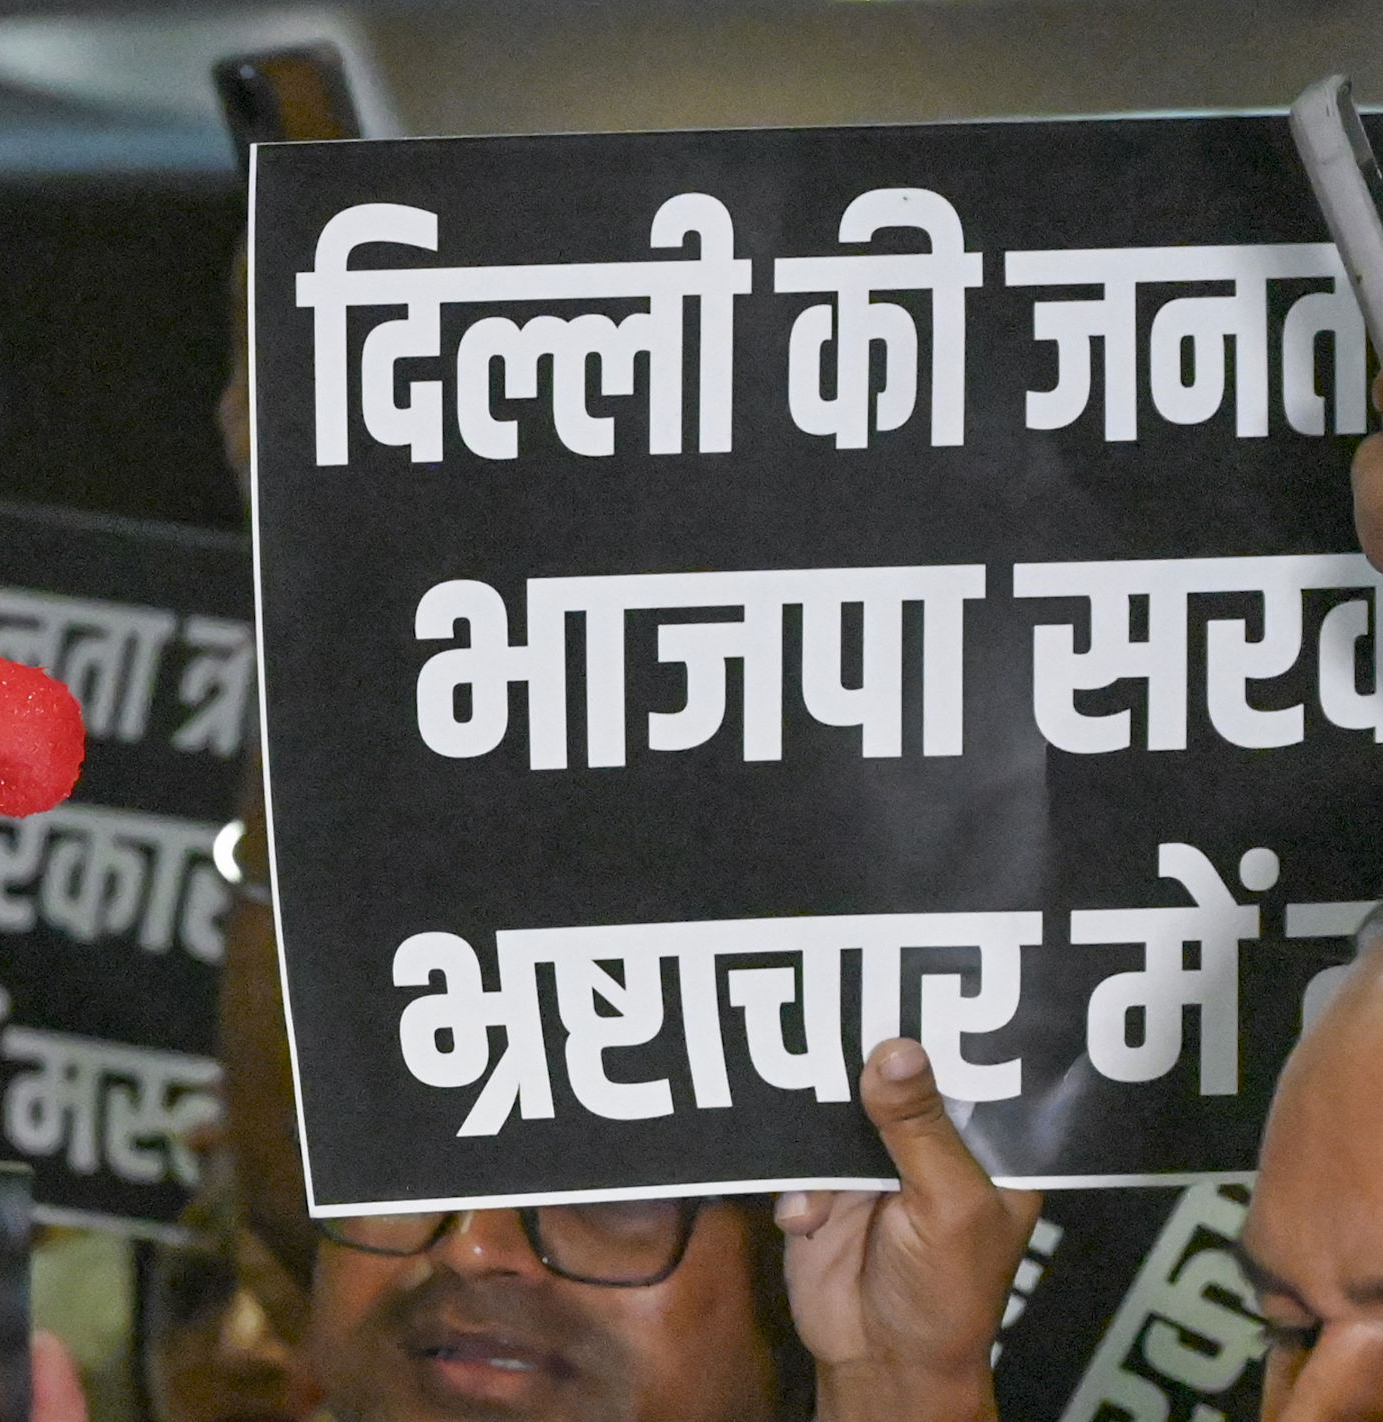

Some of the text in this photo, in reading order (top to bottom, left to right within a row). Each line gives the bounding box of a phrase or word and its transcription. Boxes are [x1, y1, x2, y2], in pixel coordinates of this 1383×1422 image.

[296, 188, 1369, 466] दिल्ली की जनत
[415, 565, 985, 770] भाजपा
[393, 912, 1042, 1136] भ्रष्टाचार
[1071, 843, 1277, 1094] में
